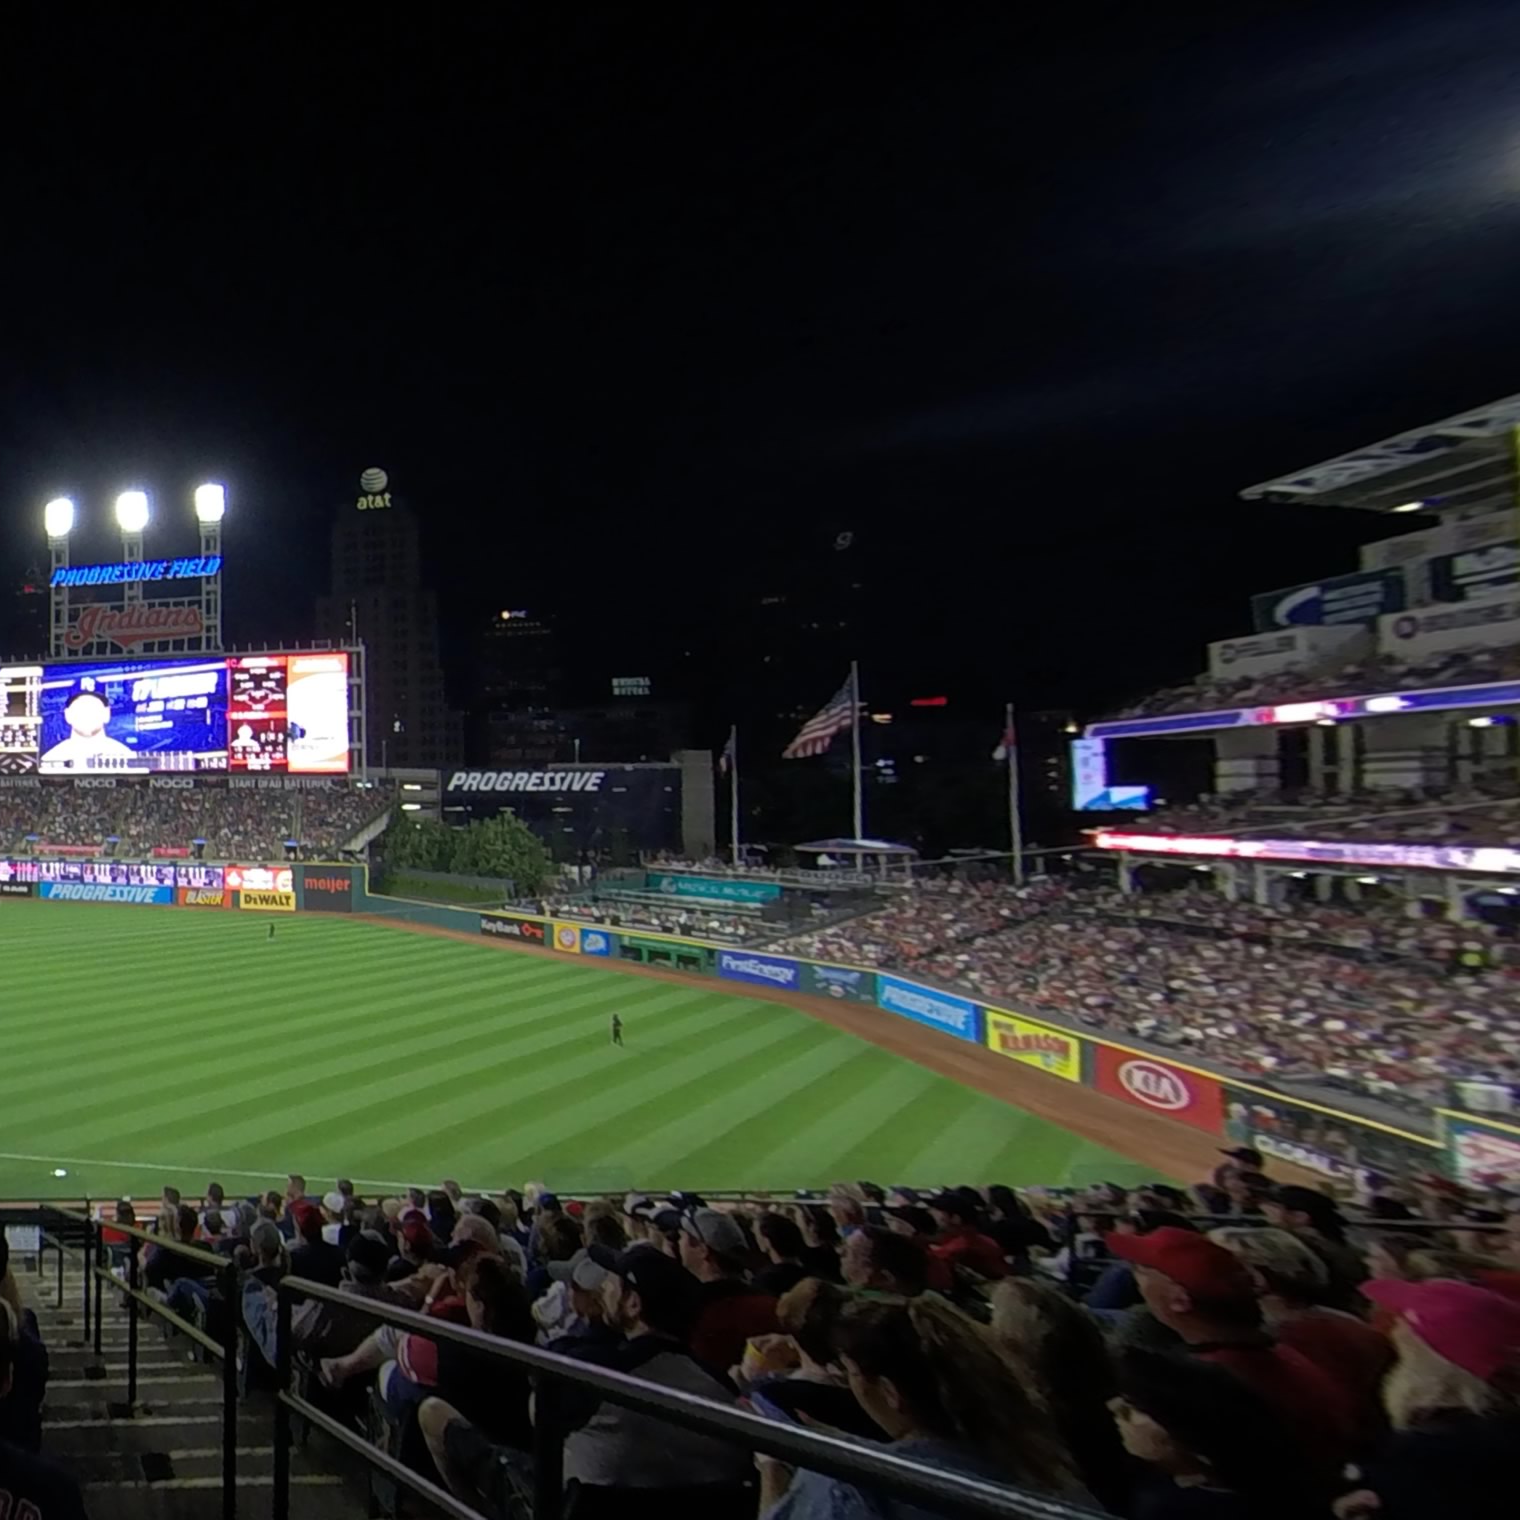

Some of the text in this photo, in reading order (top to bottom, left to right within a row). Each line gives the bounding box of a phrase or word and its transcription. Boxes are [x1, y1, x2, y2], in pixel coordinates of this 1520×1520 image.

[357, 492, 392, 510] at&t
[50, 556, 223, 588] PROGRESSIVE FIELD
[65, 604, 203, 648] Indians
[74, 779, 117, 789] NOCO
[149, 778, 194, 789] NOCO
[447, 771, 605, 792] PROGRESSIVE
[304, 876, 351, 893] meijer
[49, 885, 158, 904] PROGRESSIVE
[481, 918, 521, 936] KeyBank
[722, 954, 796, 985] FirstEnergy
[1129, 1066, 1180, 1104] KIA
